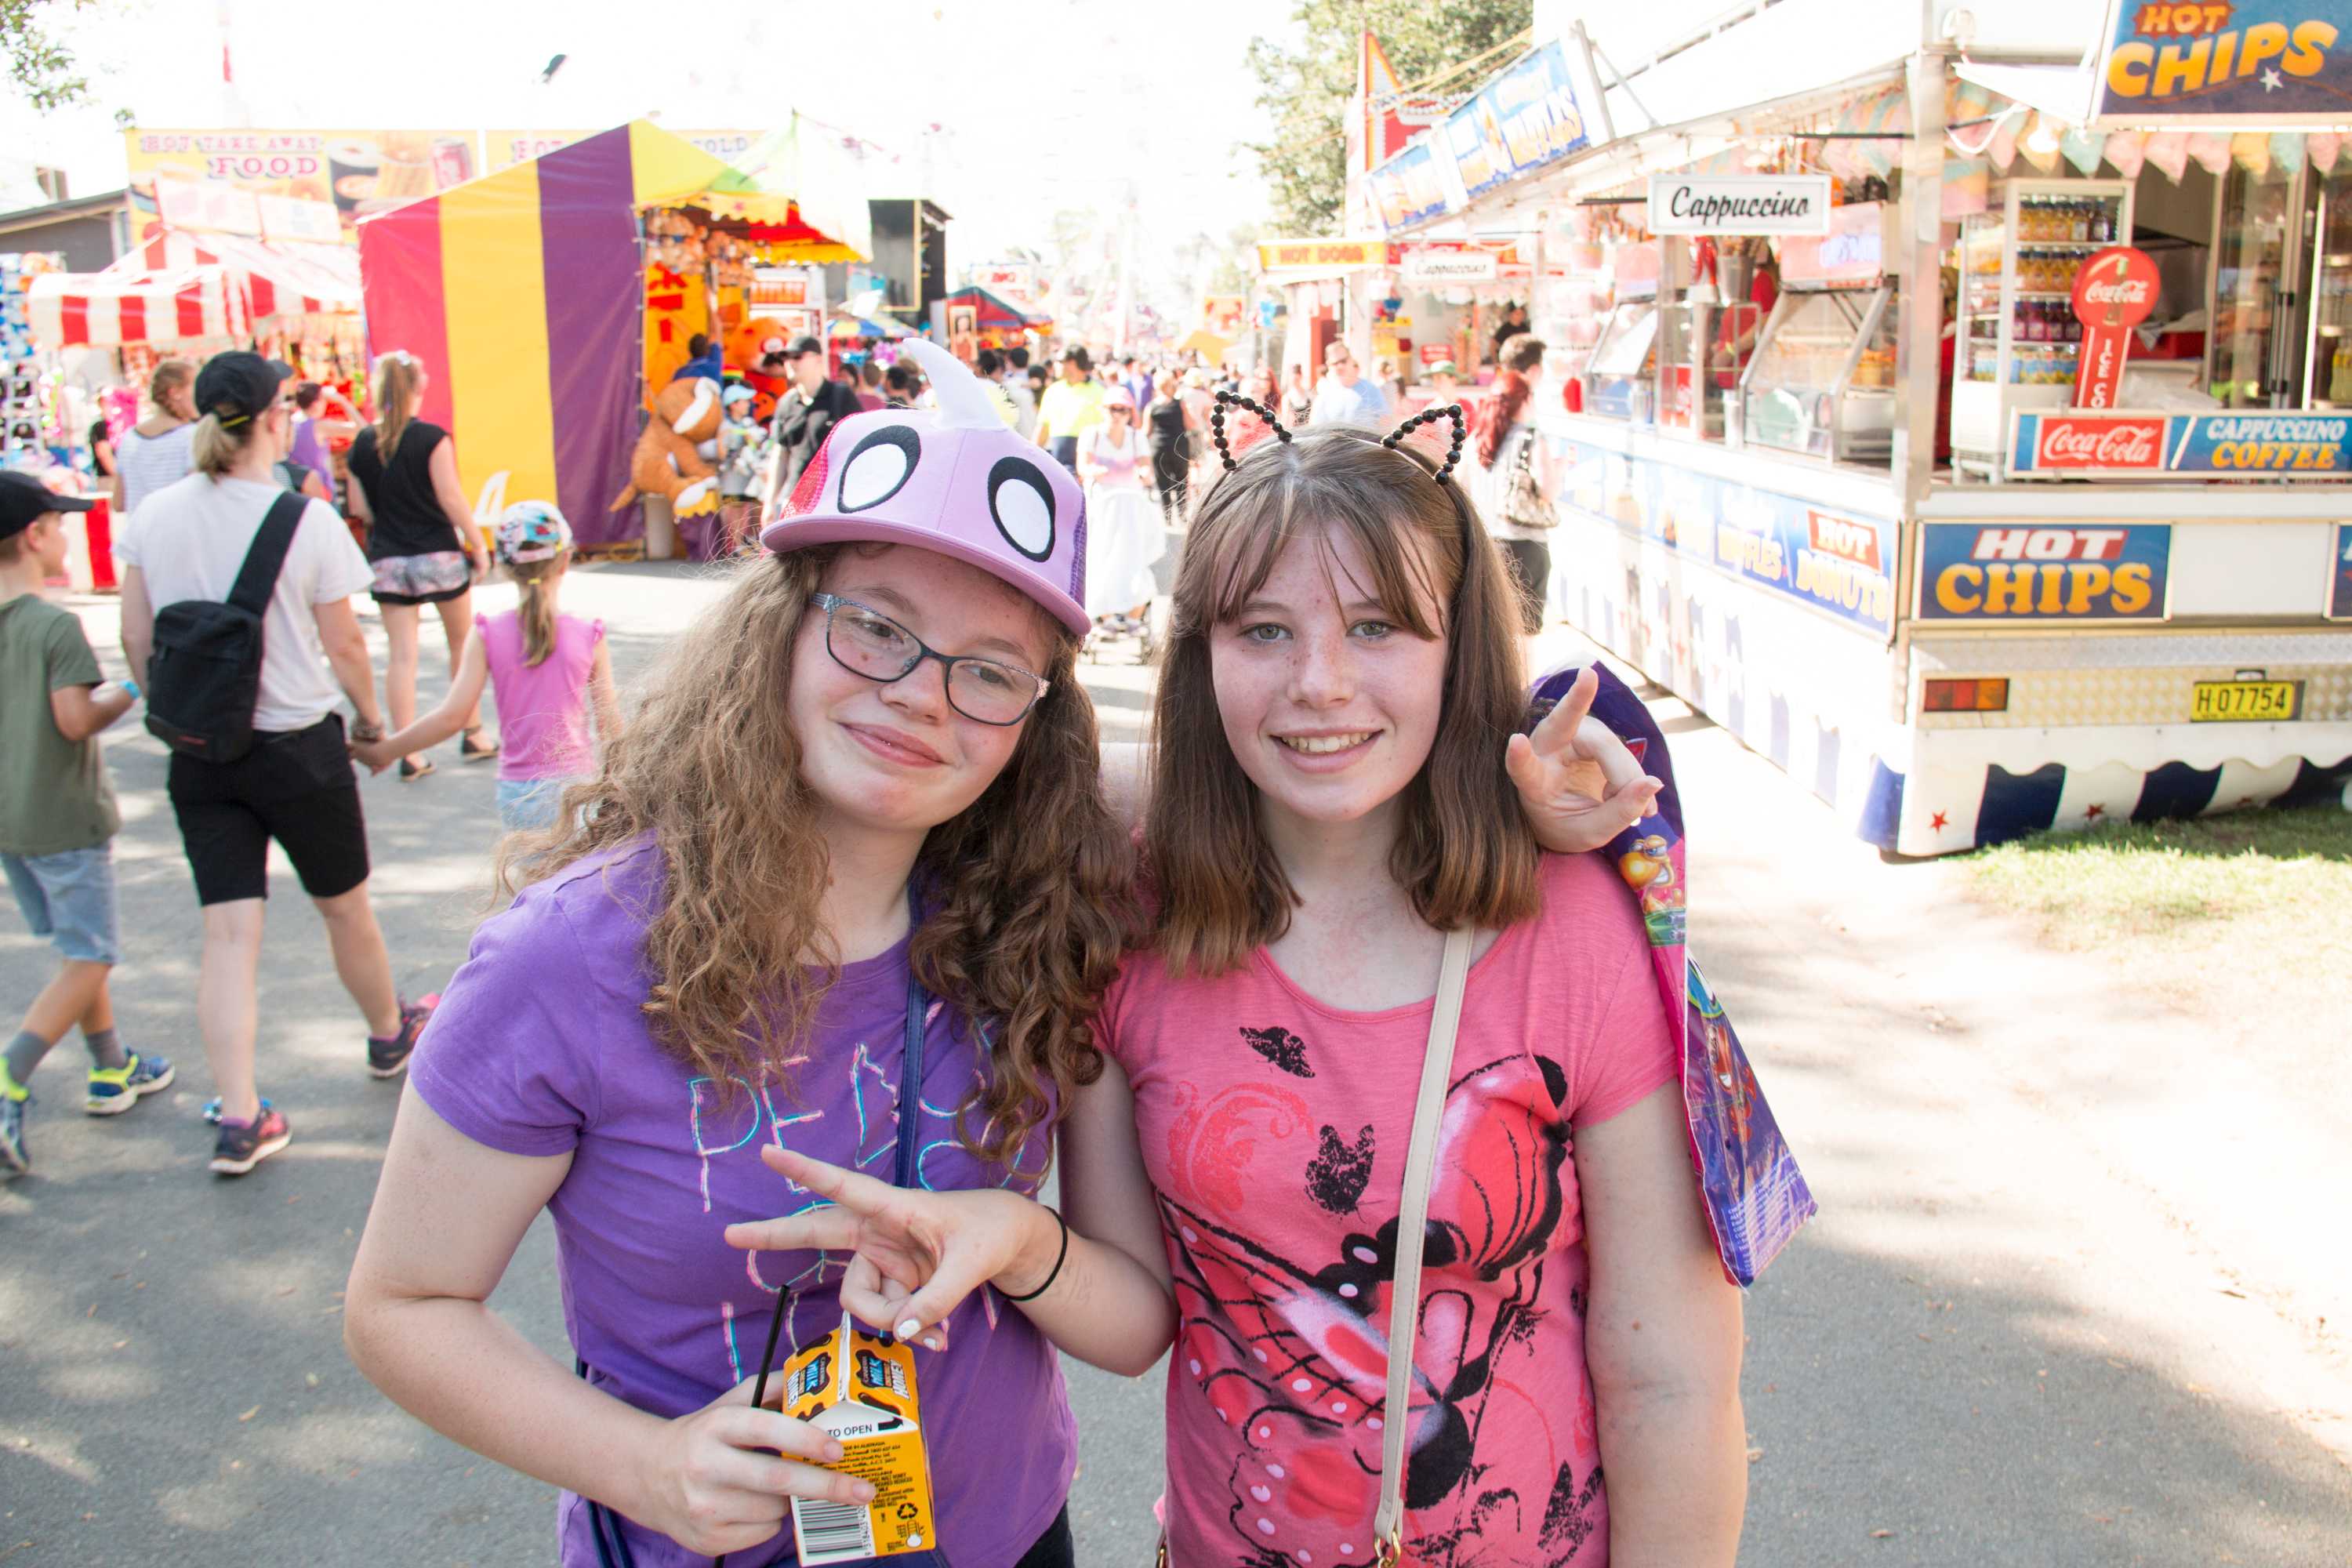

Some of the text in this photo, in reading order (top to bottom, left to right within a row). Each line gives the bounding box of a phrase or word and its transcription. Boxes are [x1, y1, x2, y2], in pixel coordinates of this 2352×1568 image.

[2141, 4, 2228, 34] HOT
[2107, 20, 2339, 97] CHIPS
[143, 136, 191, 152] HOT
[210, 157, 318, 178] FOOD
[1671, 185, 1810, 227] Cappuccino
[2085, 280, 2149, 303] Coca-Cola
[2043, 423, 2158, 463] Coca-Cola
[2206, 418, 2347, 441] CAPPUCCINO
[2211, 441, 2342, 469] COFFEE
[1816, 515, 1872, 561] HOT
[1972, 529, 2127, 561] HOT
[1935, 562, 2153, 614] CHIPS
[844, 1424, 873, 1436] OPEN
